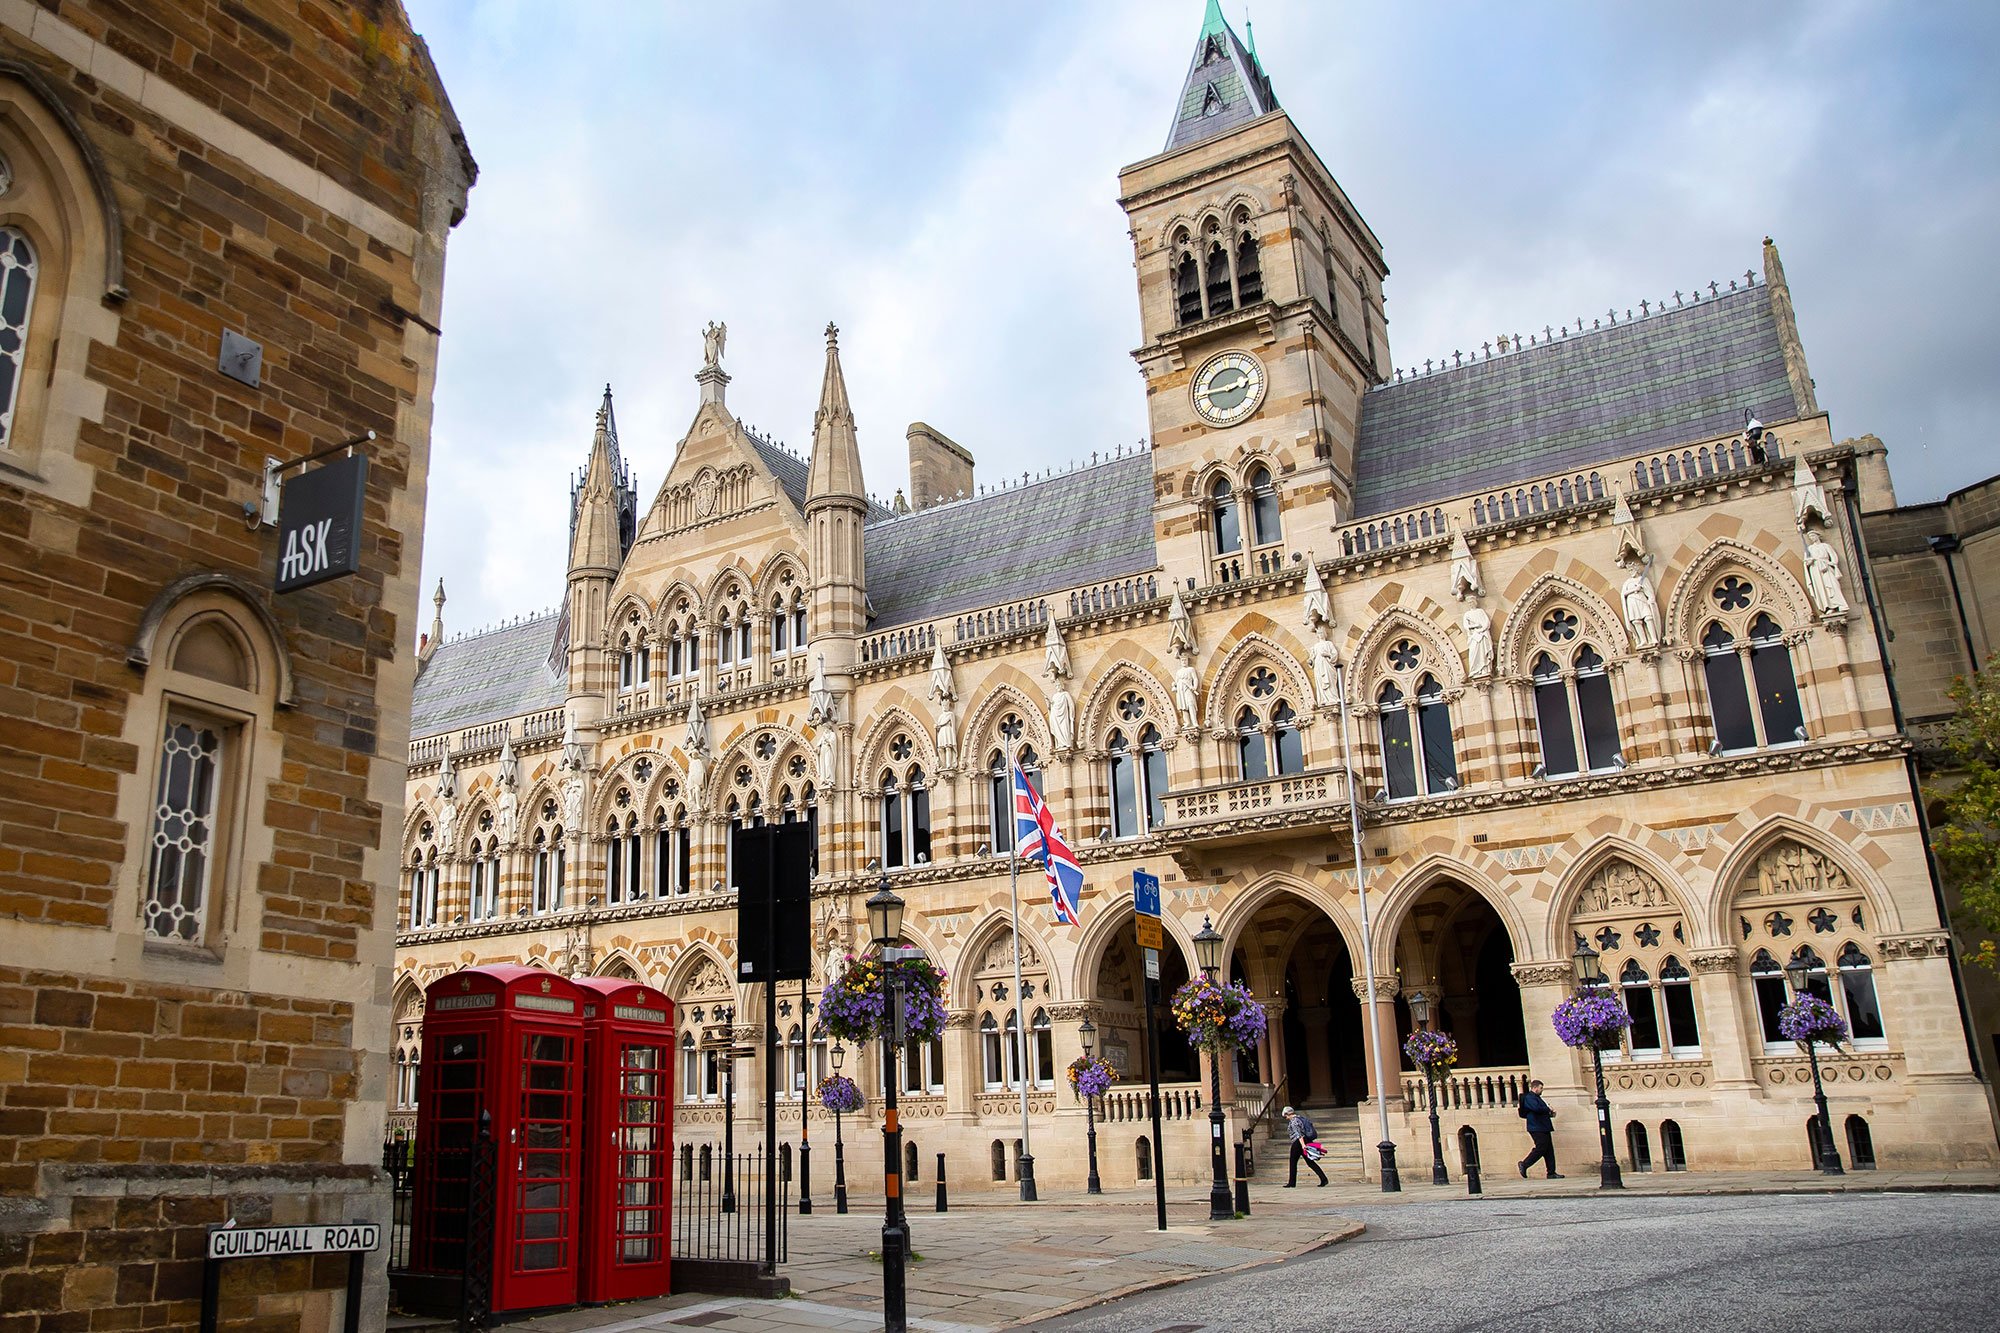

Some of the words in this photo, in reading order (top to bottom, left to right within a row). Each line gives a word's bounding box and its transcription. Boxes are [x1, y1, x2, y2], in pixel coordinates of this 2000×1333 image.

[281, 518, 332, 582] ASK
[438, 994, 493, 1009] TELEPHONE
[616, 1006, 664, 1022] TELEPHONE
[214, 1229, 313, 1255] GUILDHALL
[324, 1227, 375, 1250] ROAD
